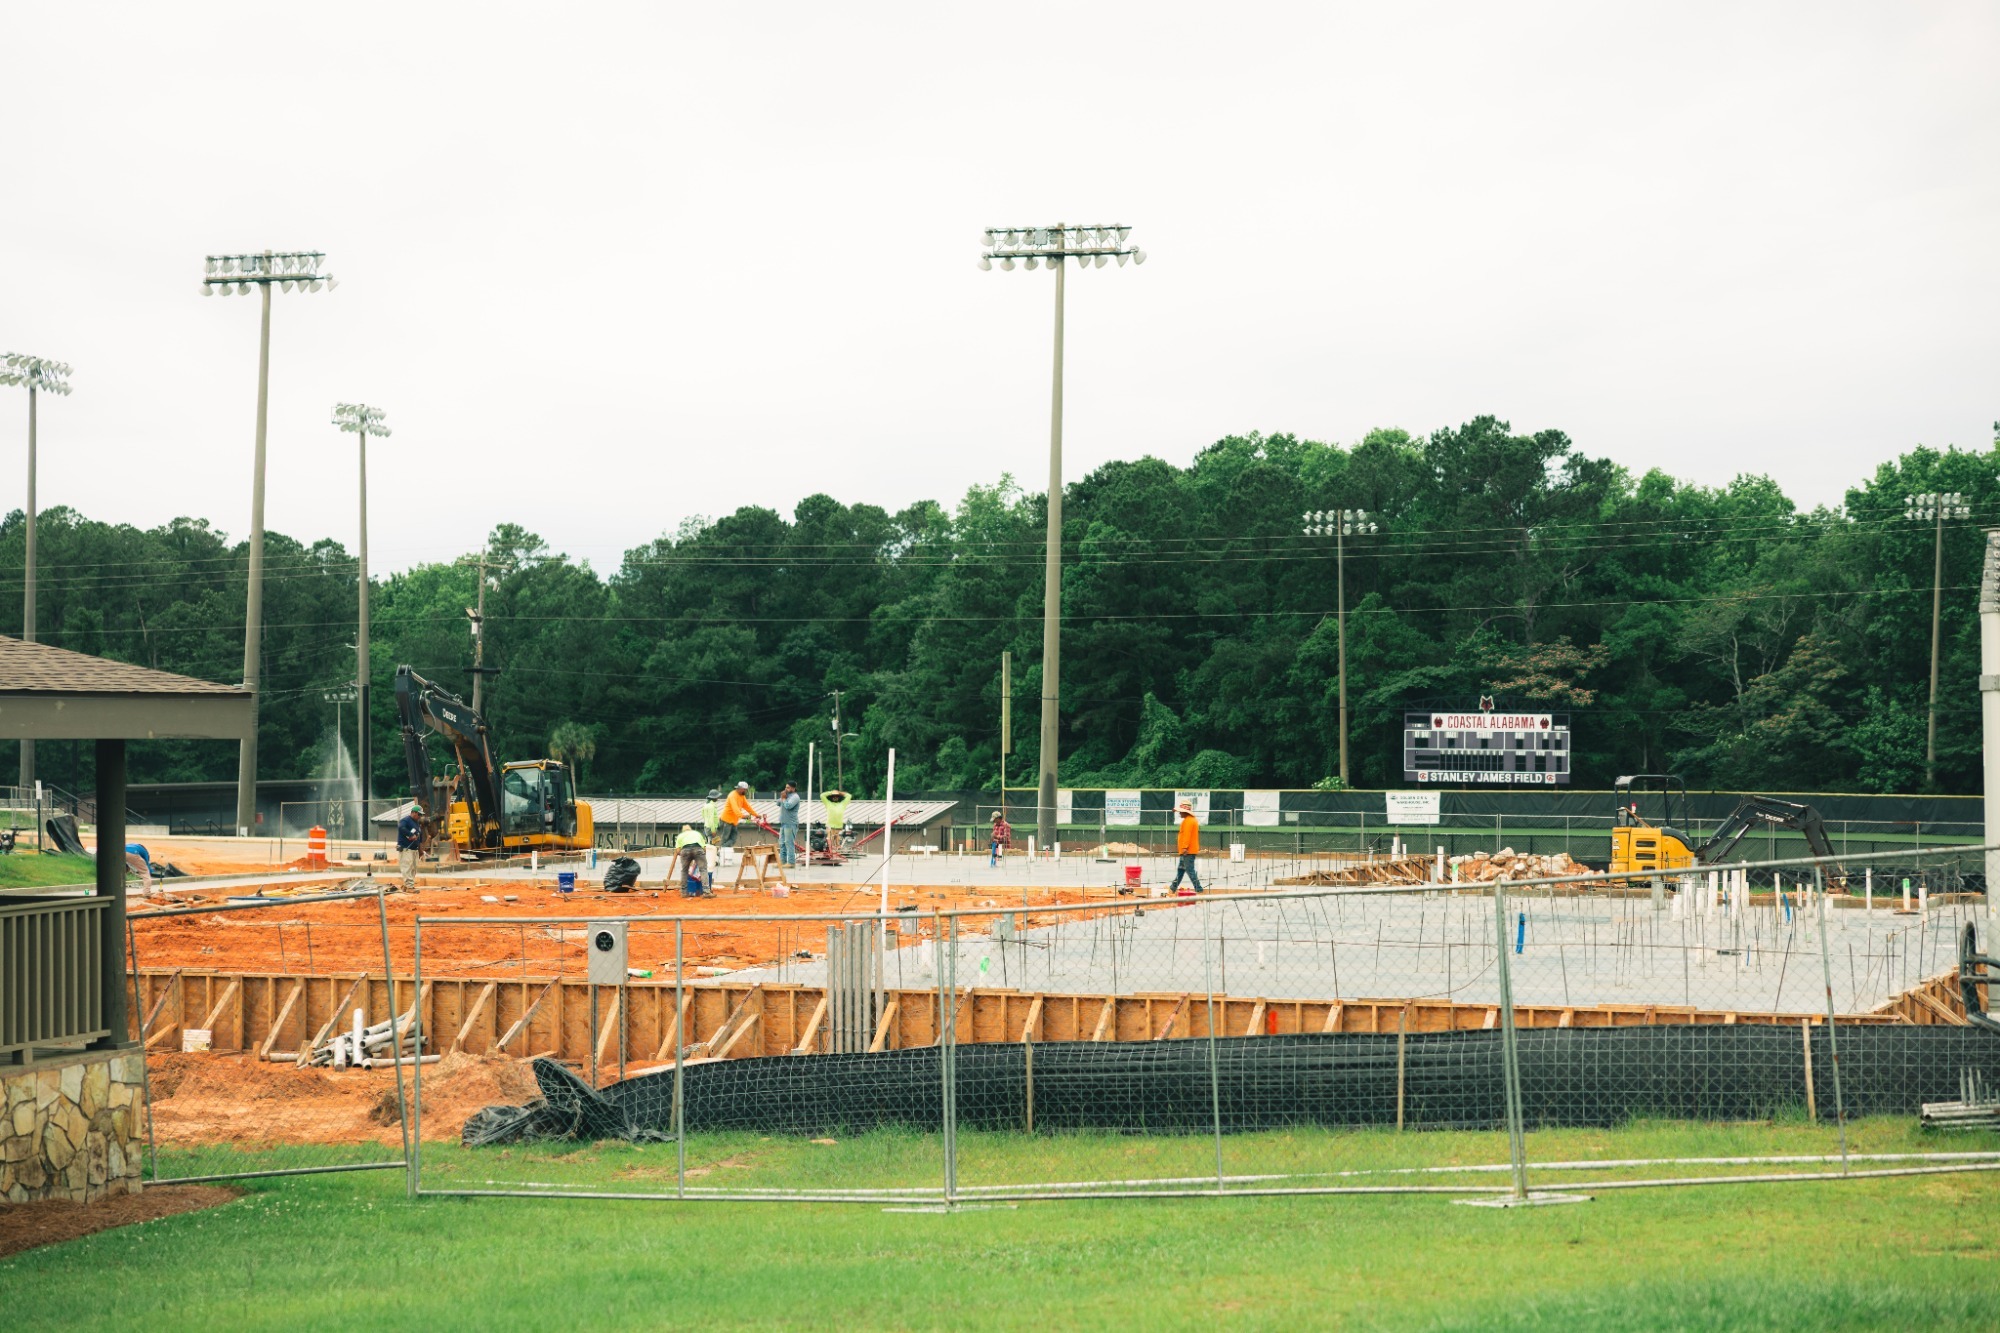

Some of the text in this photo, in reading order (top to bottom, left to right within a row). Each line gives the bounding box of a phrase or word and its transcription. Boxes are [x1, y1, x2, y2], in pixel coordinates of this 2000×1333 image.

[1447, 715, 1535, 729] COASTAL ALABAMA
[1430, 772, 1475, 782] STANLEY
[1477, 772, 1512, 783] JAMES
[1514, 773, 1542, 783] FIELD
